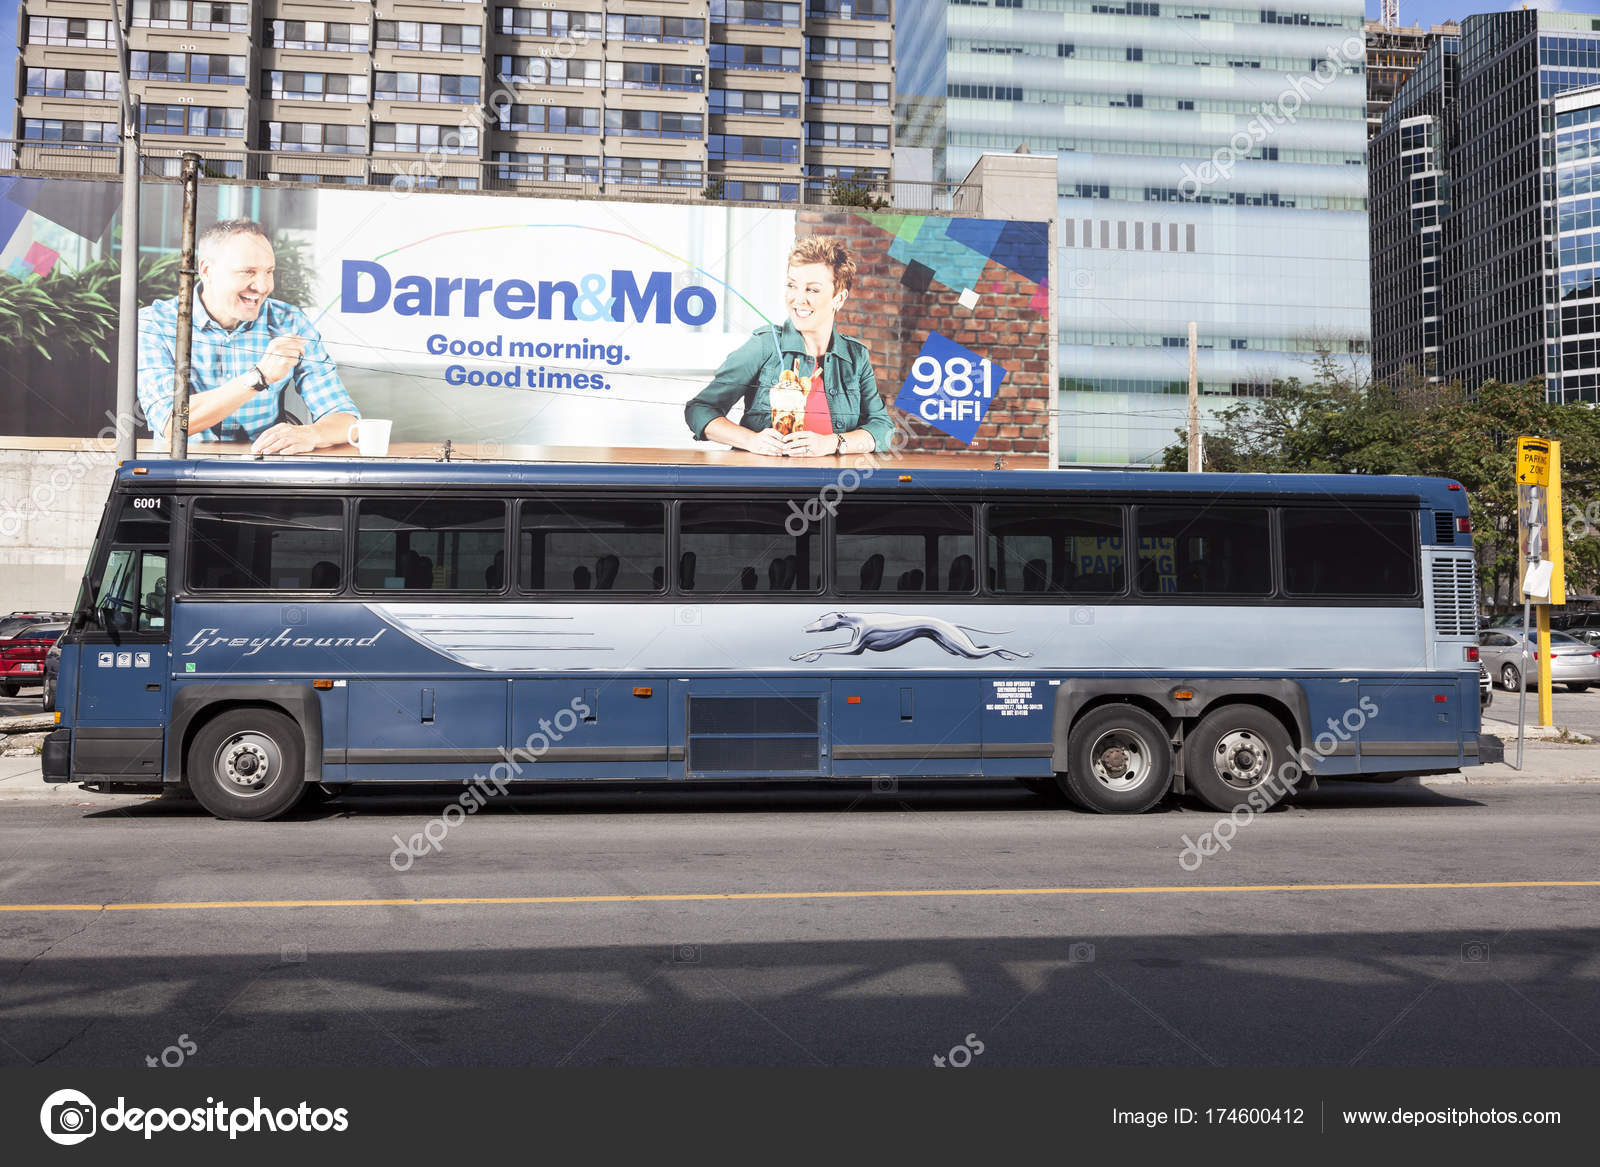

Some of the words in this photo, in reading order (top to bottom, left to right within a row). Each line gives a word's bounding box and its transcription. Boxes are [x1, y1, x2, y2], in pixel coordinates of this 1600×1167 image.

[340, 260, 717, 326] Darren&Mo
[426, 334, 502, 357] Good
[509, 338, 631, 366] morning.
[445, 365, 521, 389] Good
[526, 368, 612, 391] times.
[912, 355, 992, 398] 98.1
[920, 398, 981, 421] CHFI
[134, 498, 161, 509] 6001
[1097, 536, 1170, 550] PULIC
[182, 628, 387, 656] Greyhound
